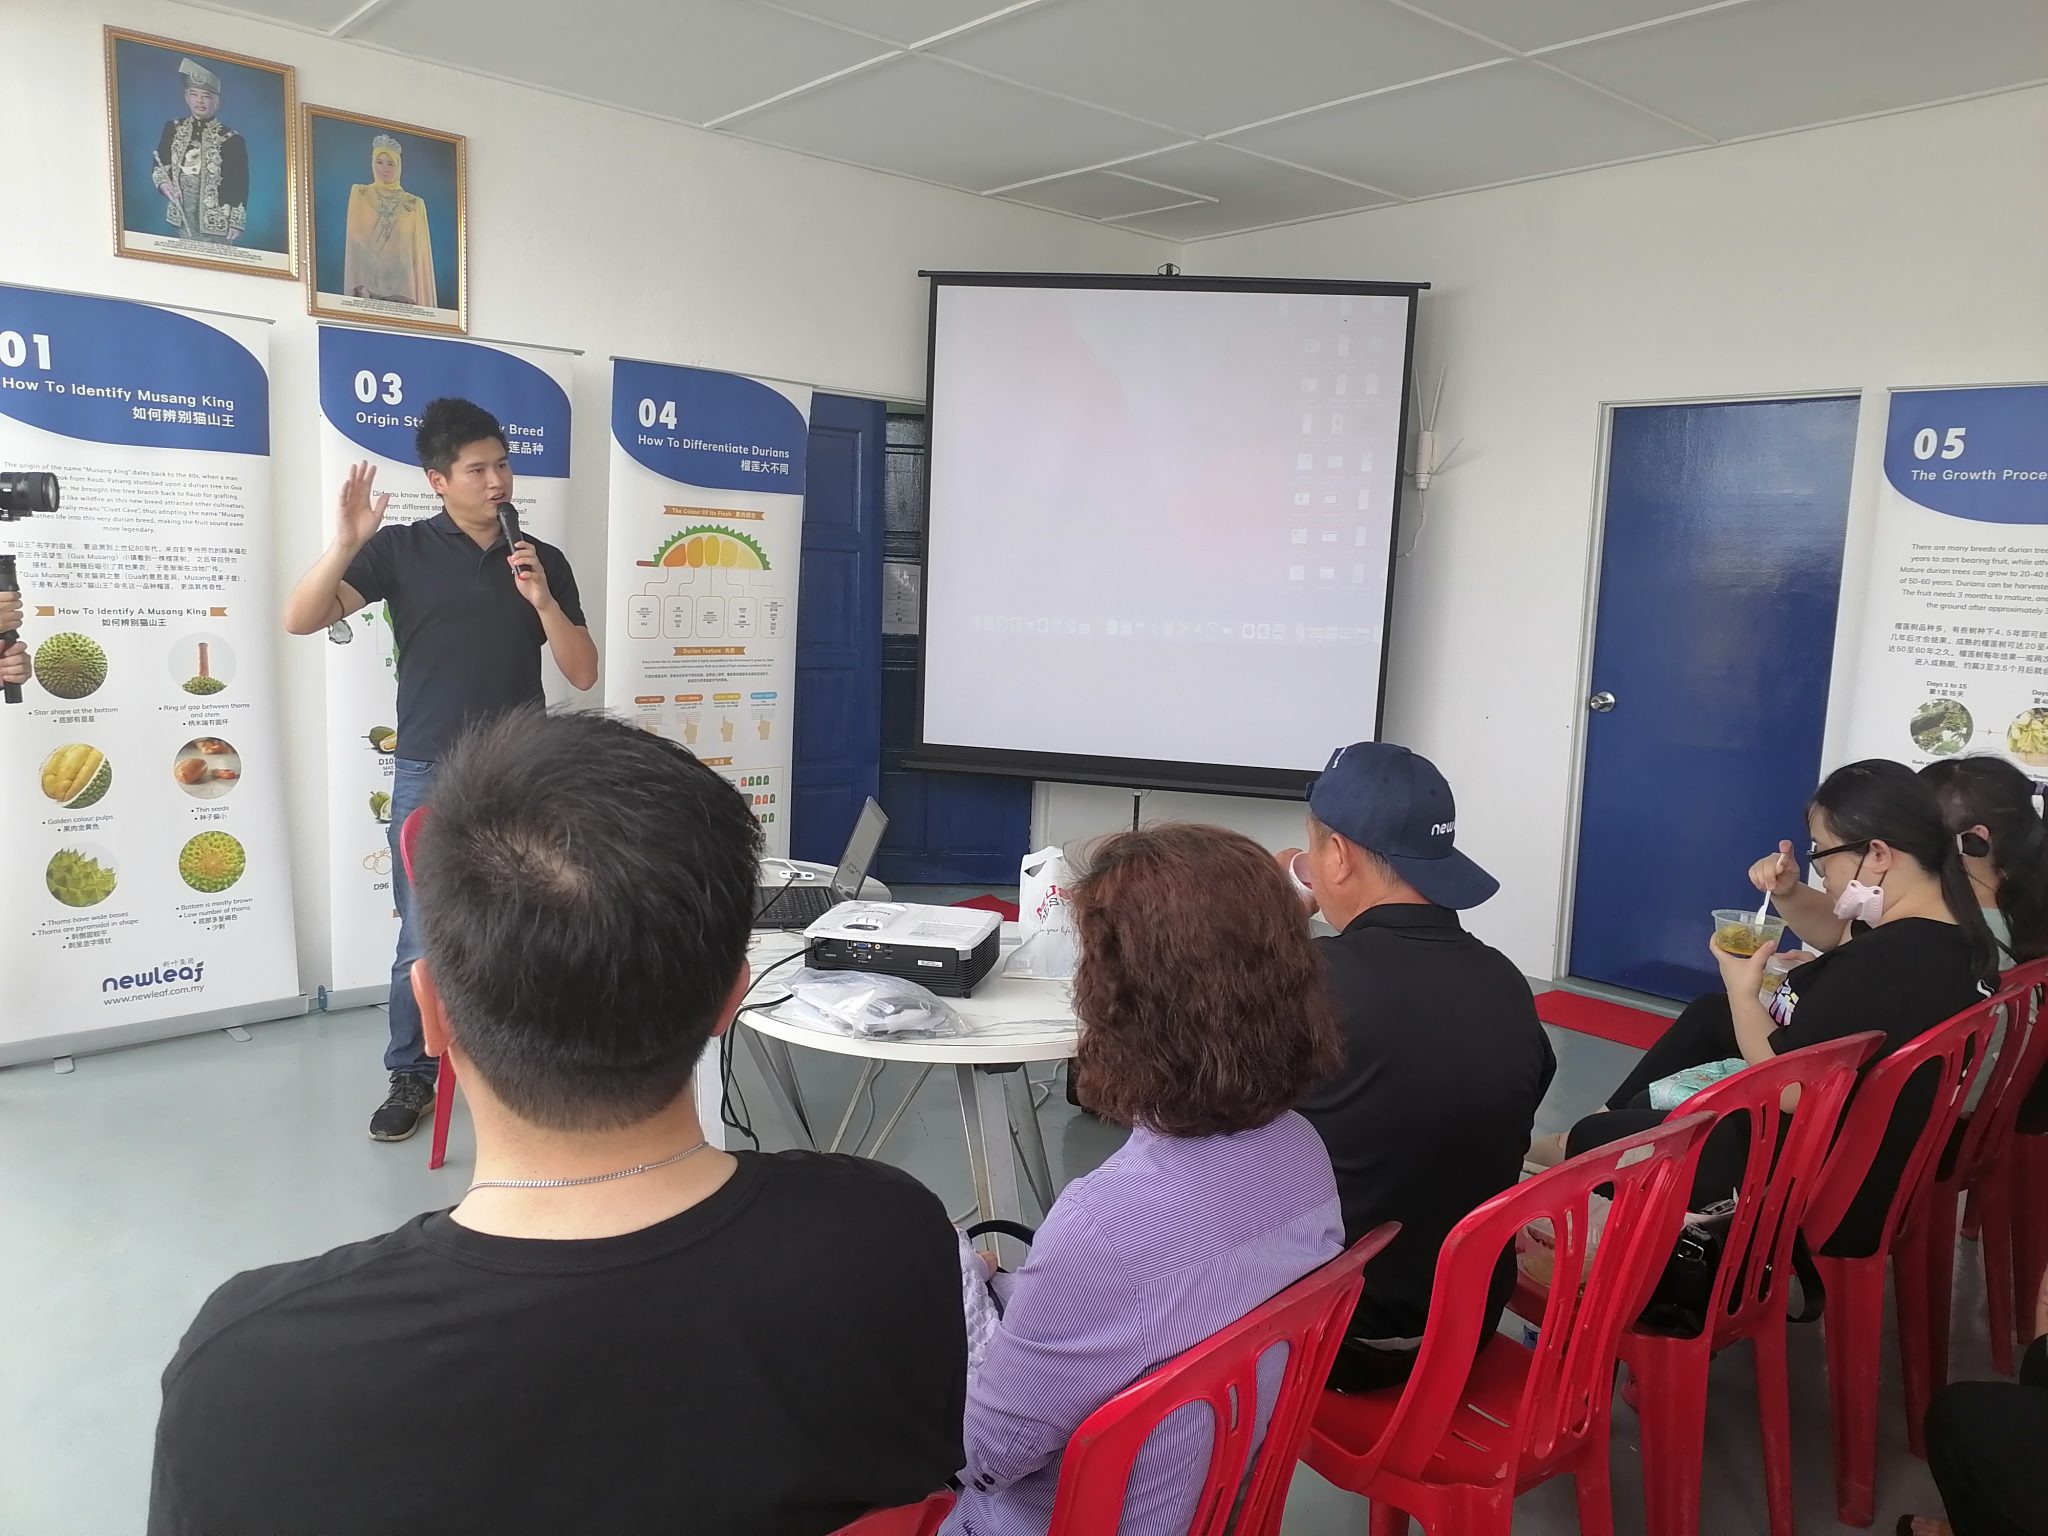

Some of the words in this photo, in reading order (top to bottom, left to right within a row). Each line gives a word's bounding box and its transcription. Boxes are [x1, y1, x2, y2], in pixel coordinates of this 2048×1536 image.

[0, 331, 51, 370] 01
[2, 377, 39, 391] How
[45, 381, 65, 394] To
[72, 384, 132, 402] Identify
[138, 390, 196, 408] Musang
[202, 396, 234, 411] King
[355, 370, 402, 405] 03
[132, 407, 235, 428] 如何辨别猫山王
[356, 412, 399, 428] Origin
[510, 424, 544, 436] Breed
[638, 398, 678, 430] 04
[638, 434, 664, 447] How
[667, 437, 680, 448] To
[683, 439, 749, 454] Differentiate
[752, 446, 790, 458] Durians
[1914, 428, 1966, 460] 05
[741, 460, 788, 475] 榴莲大不同
[1911, 470, 1936, 481] The
[1942, 470, 1996, 481] Growth
[402, 503, 429, 511] different
[1961, 557, 1990, 565] bearing
[98, 608, 134, 616] Identify
[148, 608, 183, 616] Musang
[187, 608, 207, 616] King
[1988, 607, 2043, 615] approximately
[51, 708, 71, 716] shape
[76, 922, 109, 932] pyramidal
[102, 961, 204, 992] newleaf
[104, 985, 205, 1005] www.newleaf.com.my
